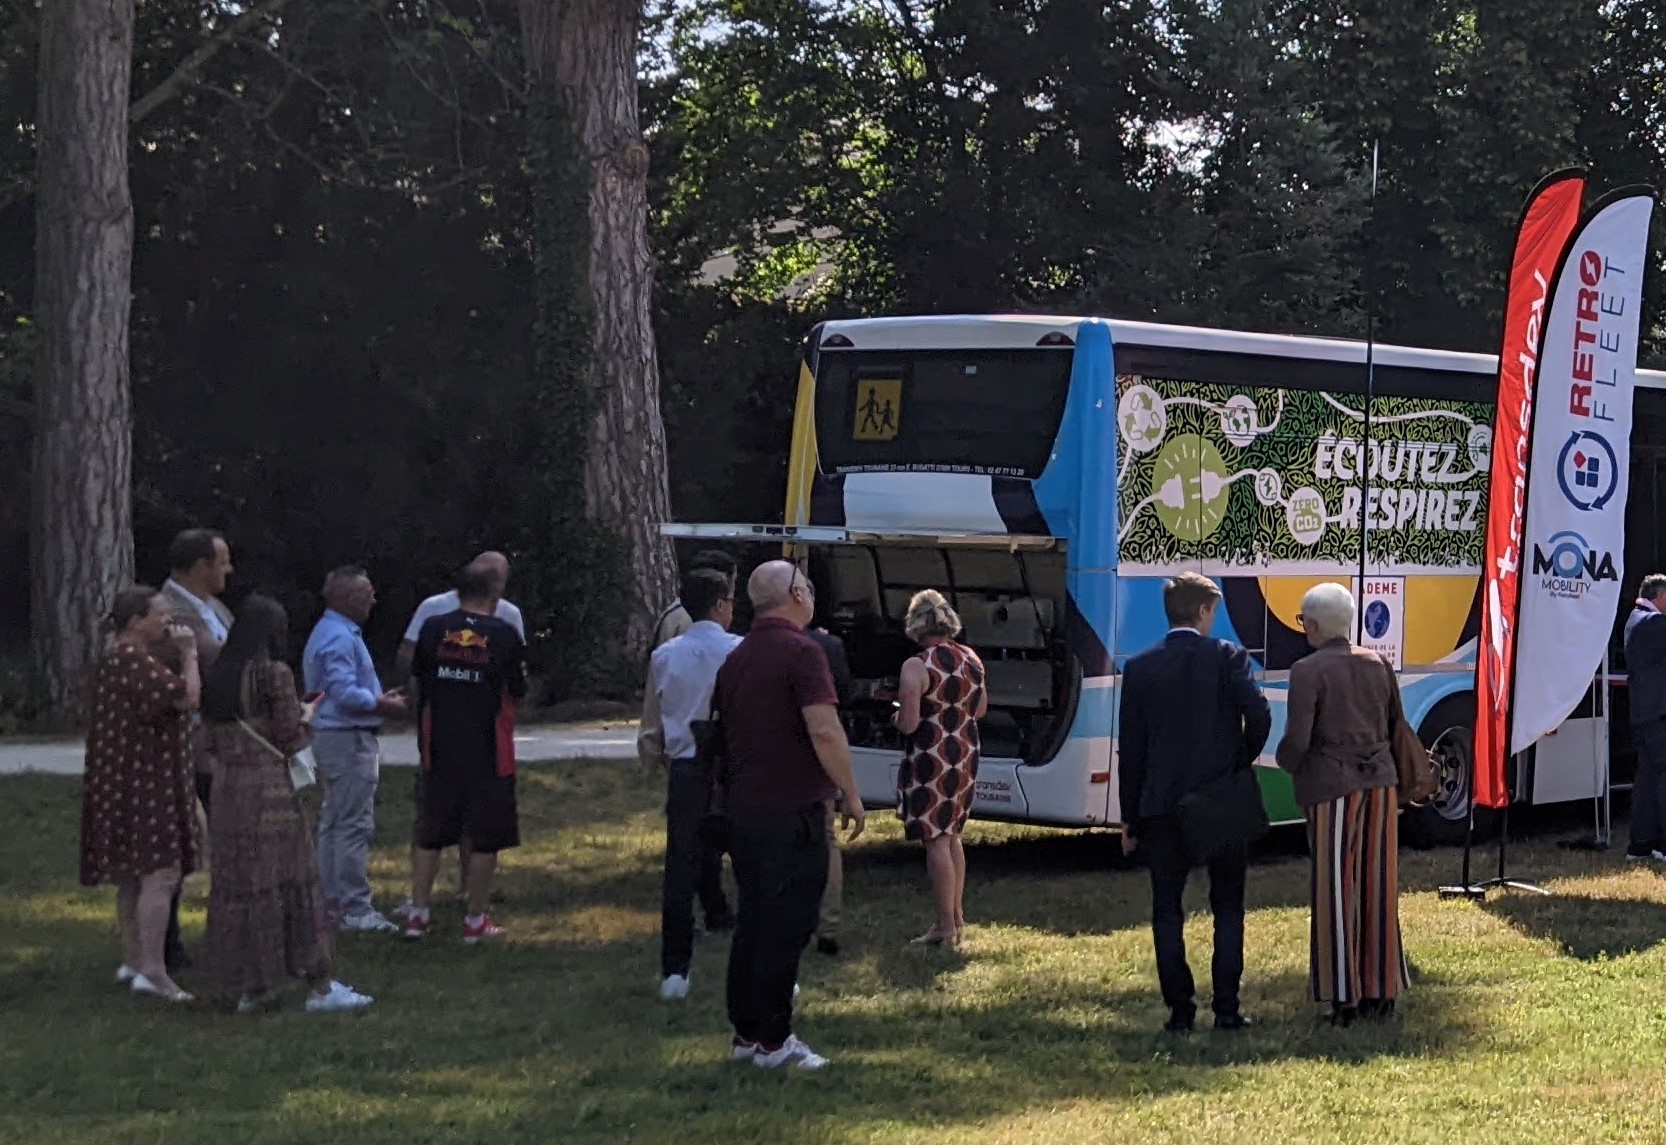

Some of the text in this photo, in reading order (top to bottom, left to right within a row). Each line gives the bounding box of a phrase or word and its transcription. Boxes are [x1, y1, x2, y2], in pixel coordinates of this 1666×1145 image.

[1570, 250, 1601, 417] RETRO
[1594, 257, 1625, 421] FLEET
[1314, 429, 1461, 483] ÉCOUTEZ
[1293, 499, 1320, 511] ZERO
[1340, 485, 1480, 531] RESPIREZ
[1532, 542, 1619, 581] MONA
[1362, 582, 1398, 594] DEME
[1541, 579, 1592, 594] MOBILITY
[438, 666, 470, 681] Mobil
